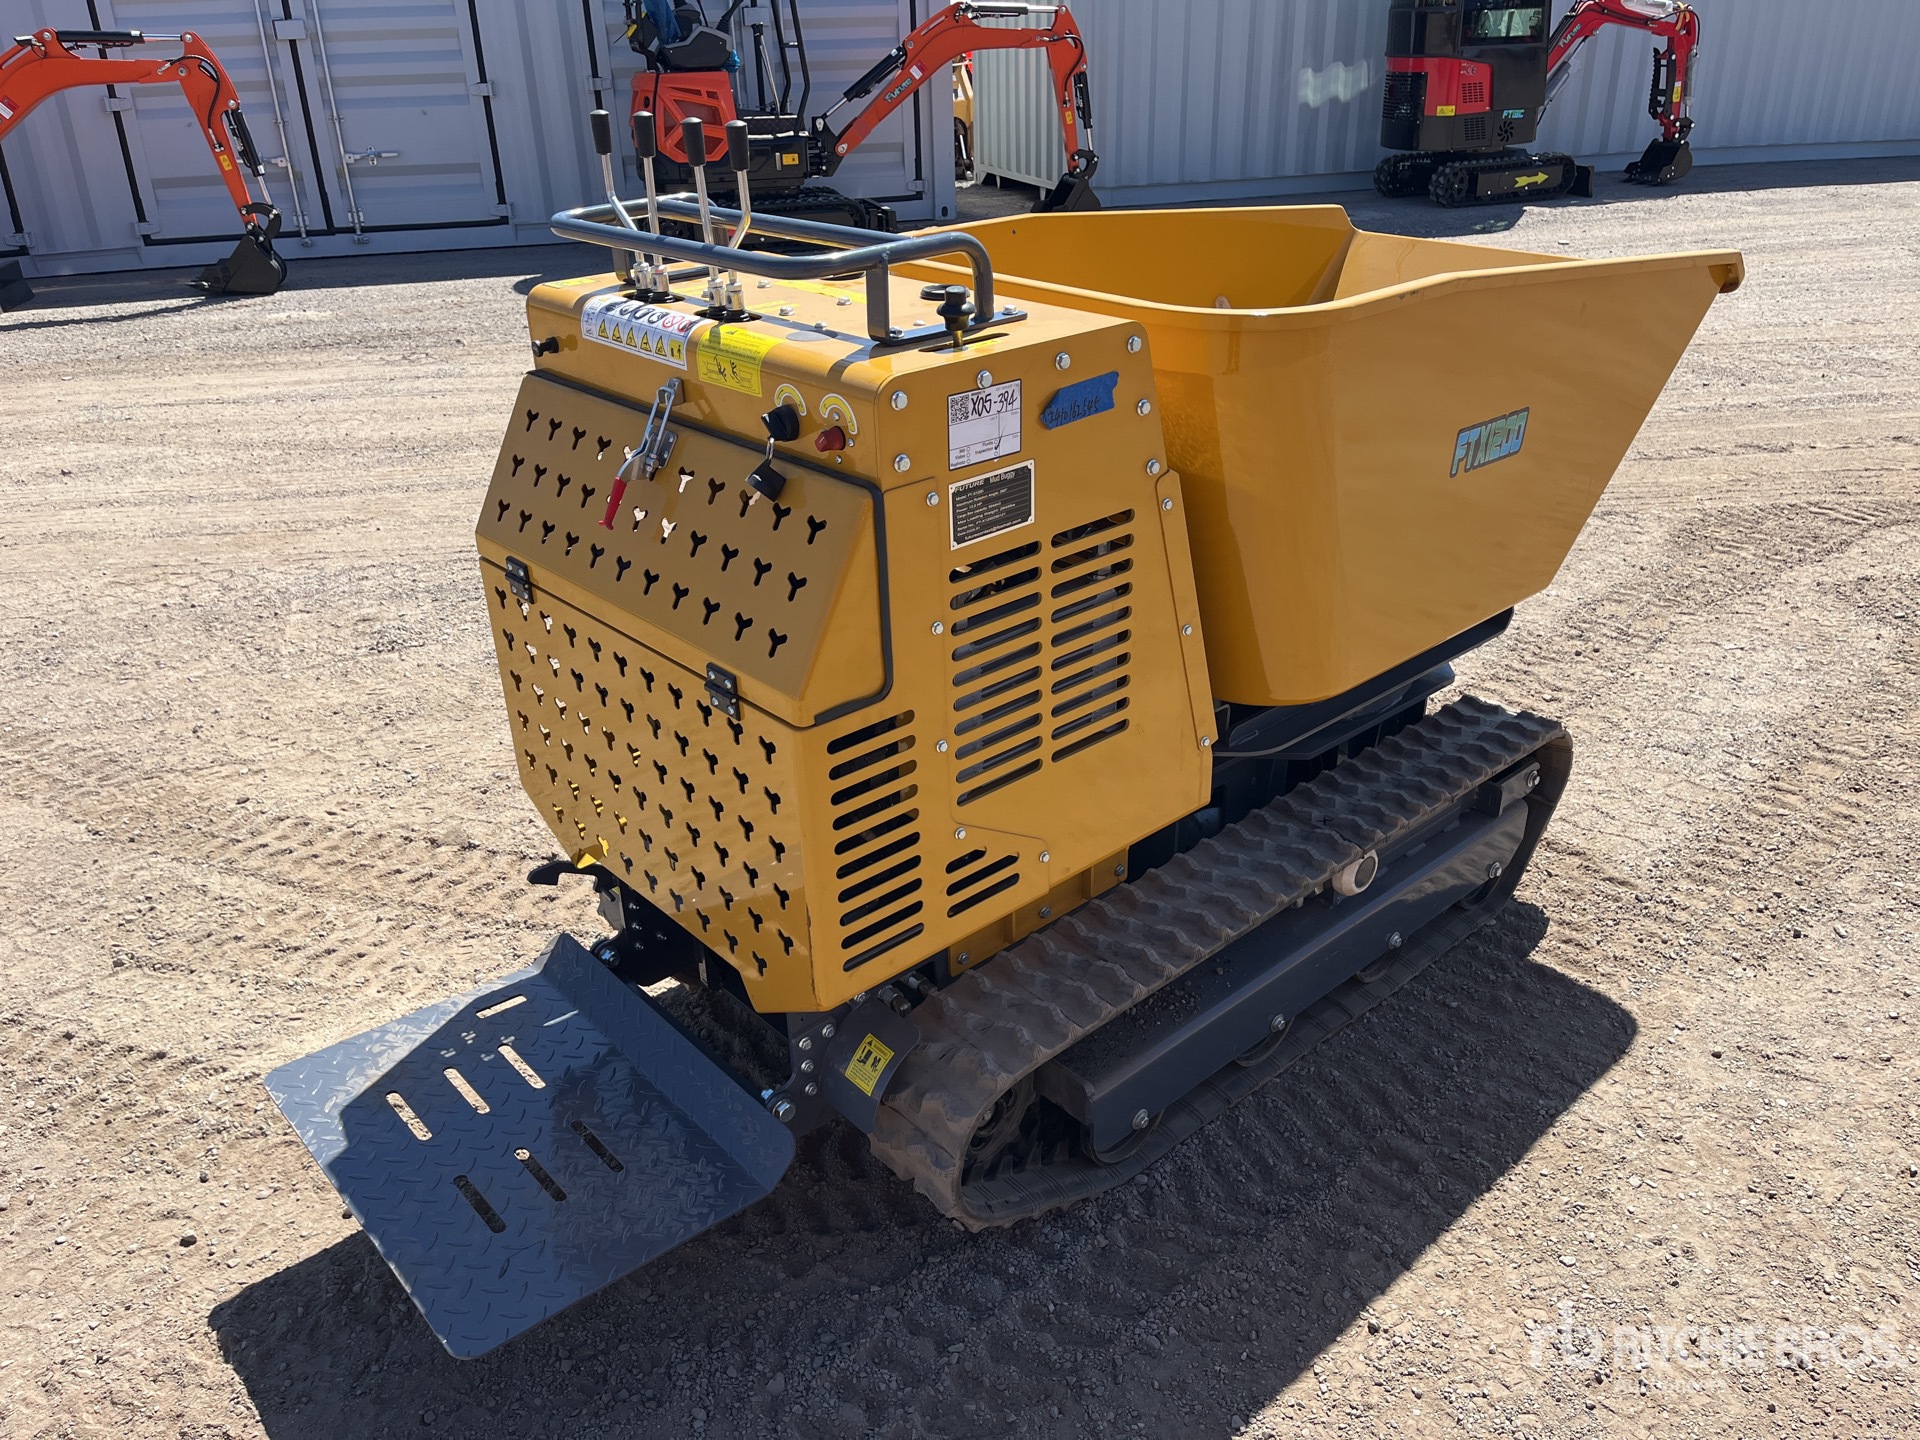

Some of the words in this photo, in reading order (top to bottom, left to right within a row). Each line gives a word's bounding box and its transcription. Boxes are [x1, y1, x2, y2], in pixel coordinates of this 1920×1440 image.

[971, 389, 1018, 417] X05-394
[1450, 406, 1530, 479] FTX1200
[954, 478, 985, 493] FUTURE
